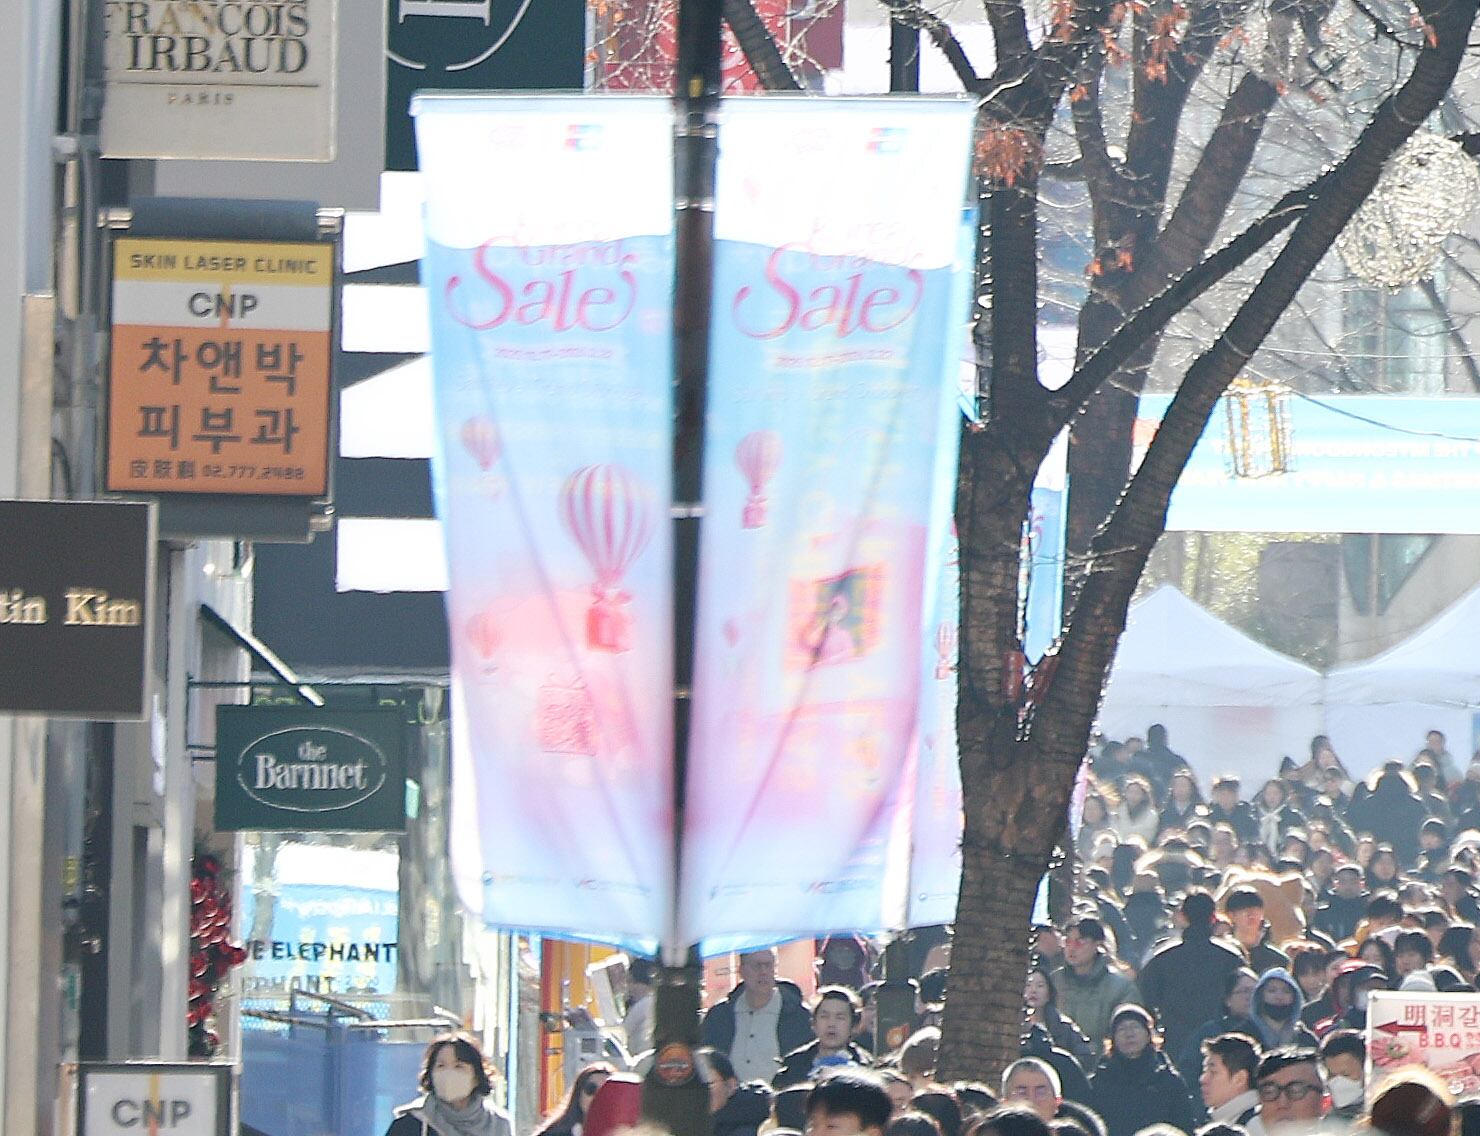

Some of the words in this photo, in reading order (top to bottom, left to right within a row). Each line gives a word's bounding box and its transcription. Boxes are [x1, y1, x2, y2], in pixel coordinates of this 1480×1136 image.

[130, 254, 177, 270] SKIN
[184, 256, 247, 274] LASER
[254, 258, 319, 275] CLINIC
[445, 237, 639, 332] Sale
[730, 242, 925, 338] Sale
[187, 291, 259, 320] CNP
[137, 337, 305, 397] 차앤박
[136, 404, 301, 455] 피부과
[64, 589, 140, 626] Kim
[298, 741, 328, 760] the
[253, 754, 368, 790] Barnnet
[271, 942, 398, 963] ELEPHANT
[111, 1099, 192, 1129] CNP
